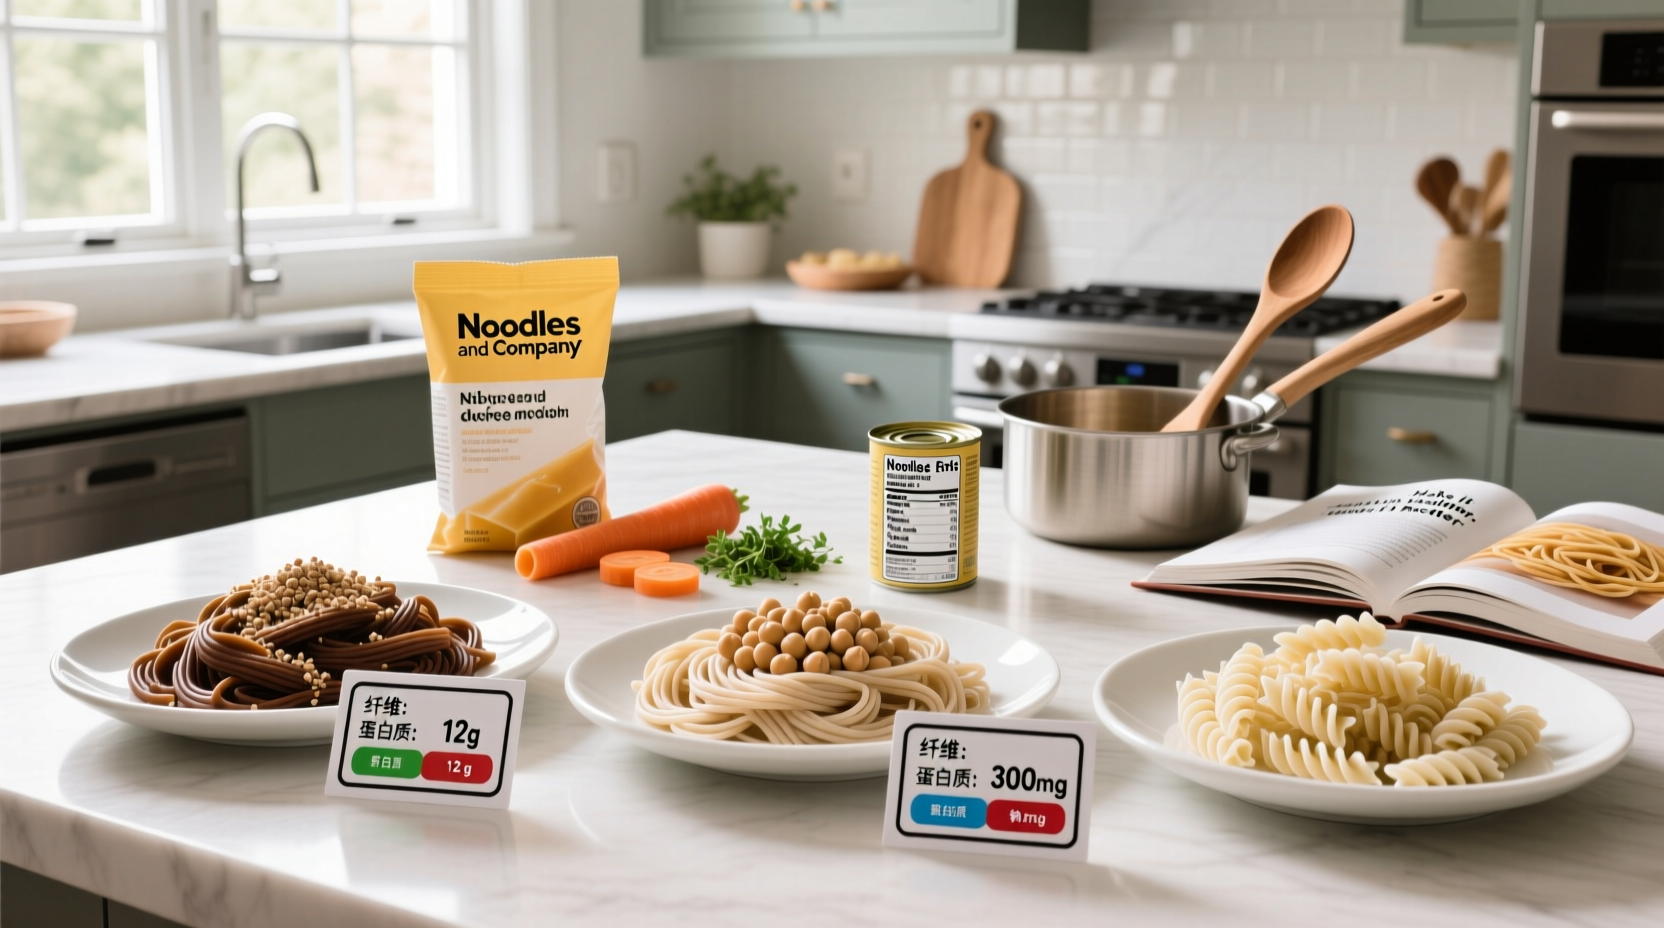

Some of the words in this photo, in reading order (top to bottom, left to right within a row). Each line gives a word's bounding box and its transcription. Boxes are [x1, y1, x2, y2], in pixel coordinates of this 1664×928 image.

[457, 310, 581, 339] Noodles
[458, 341, 489, 357] and
[493, 339, 582, 359] Company
[363, 695, 407, 717] 纤维：
[358, 720, 417, 742] 蛋白质：
[443, 718, 480, 750] 12g
[919, 737, 966, 760] 纤维：
[916, 766, 978, 788] 蛋白质：
[990, 765, 1068, 800] 300mg
